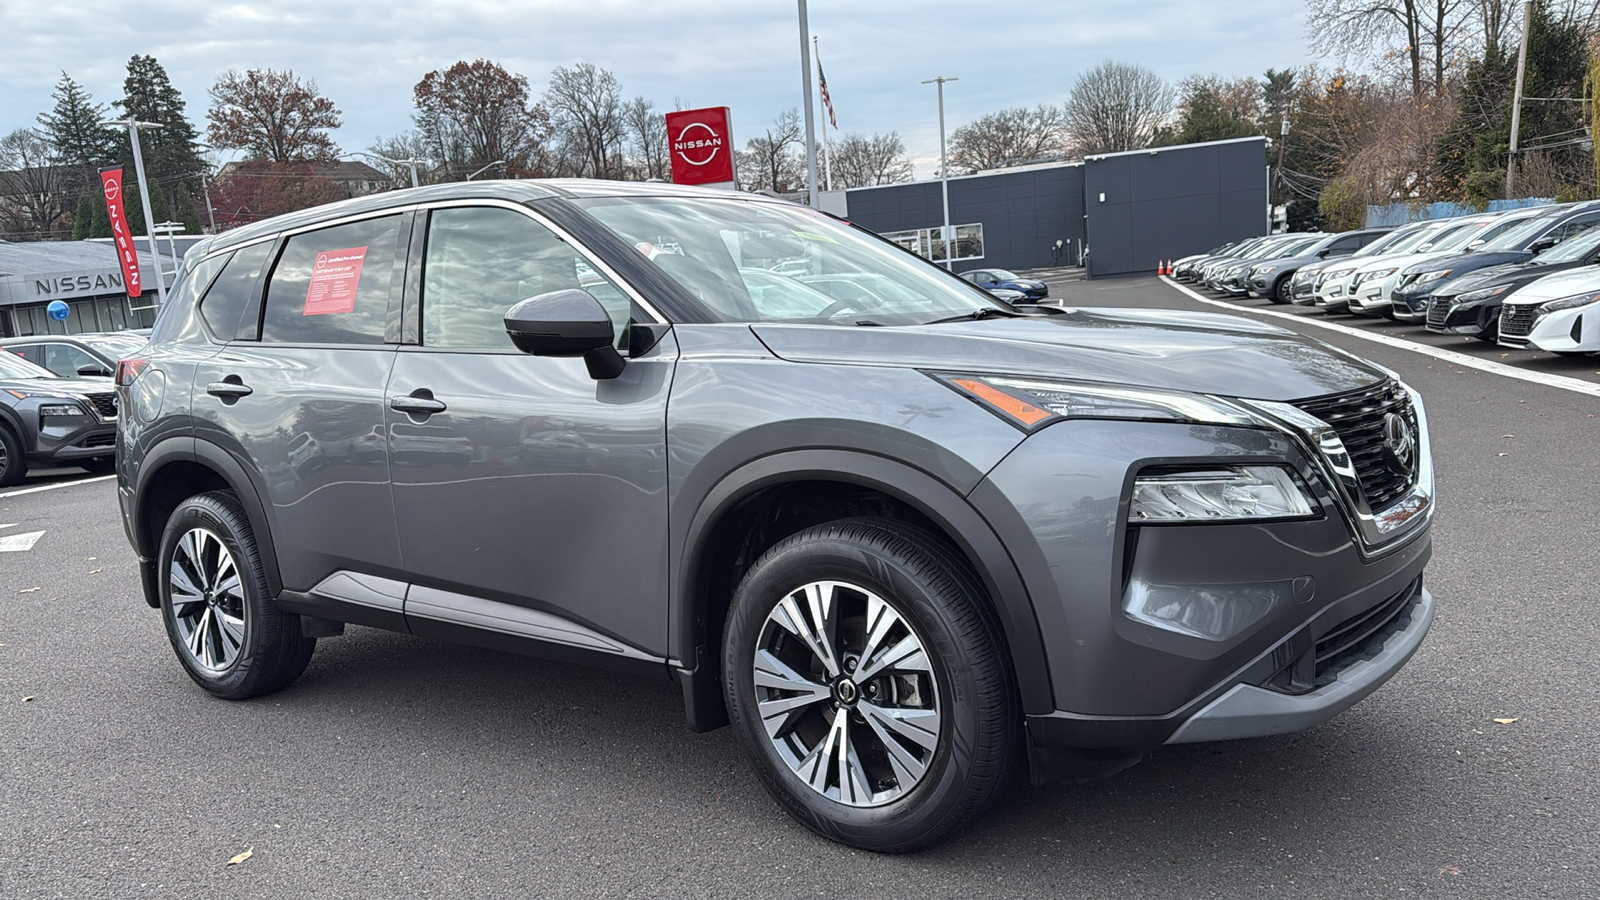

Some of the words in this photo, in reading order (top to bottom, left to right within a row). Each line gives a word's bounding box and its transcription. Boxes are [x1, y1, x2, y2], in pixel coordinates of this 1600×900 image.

[674, 138, 721, 150] NISSAN
[110, 204, 139, 285] NISSAN
[36, 274, 121, 294] NISSAN
